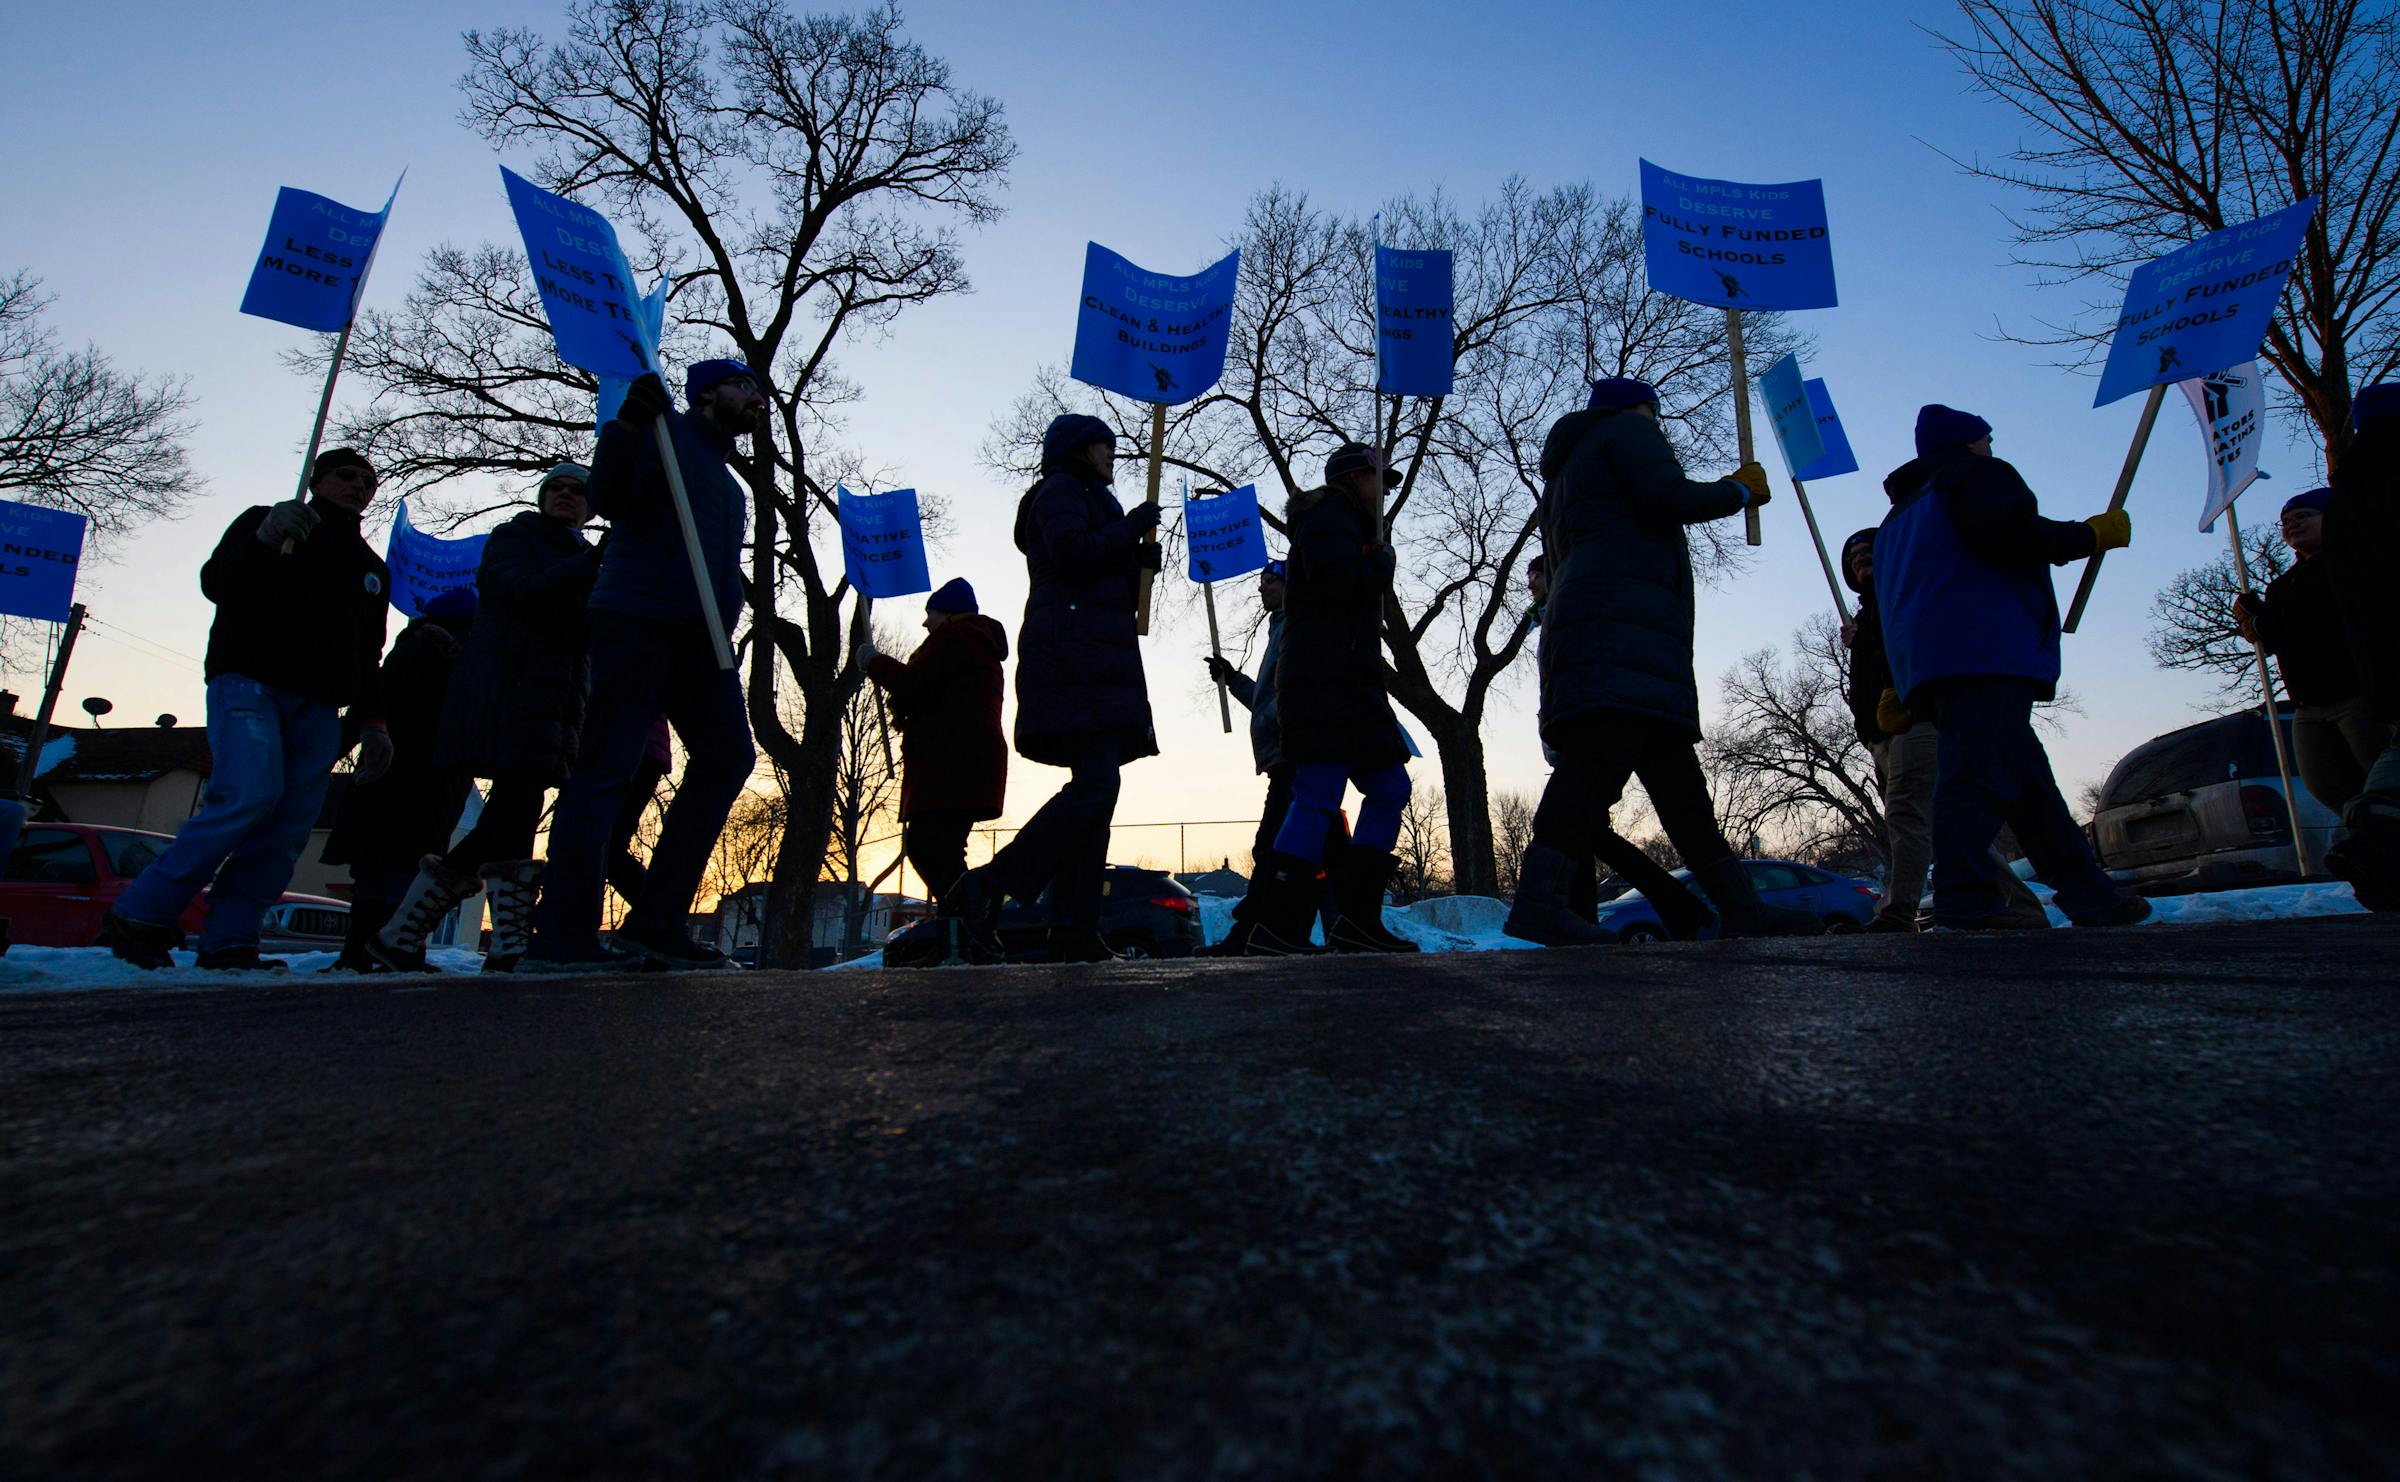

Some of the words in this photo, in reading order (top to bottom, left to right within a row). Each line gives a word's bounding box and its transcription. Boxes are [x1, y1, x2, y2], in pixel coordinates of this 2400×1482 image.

[1662, 175, 1690, 192] ALL
[1695, 183, 1743, 199] MPLS
[1749, 190, 1790, 201] KIDS
[311, 202, 351, 224] ALL
[532, 193, 565, 219] ALL
[1679, 196, 1774, 220] DESERVE
[1644, 204, 1711, 237] FULLY
[1721, 225, 1826, 241] FUNDED
[283, 235, 354, 269] LESS
[555, 226, 616, 261] DESE
[1677, 240, 1785, 265] SCHOOLS
[2152, 260, 2176, 276] ALL
[2183, 234, 2231, 262] MPLS
[2238, 219, 2282, 241] KIDS
[263, 256, 340, 288] MORE
[540, 248, 597, 286] LESS
[1390, 256, 1424, 269] KIDS
[2158, 248, 2256, 293] DESERVE
[1113, 261, 1138, 282] ALL
[1143, 276, 1190, 293] MPLS
[538, 275, 600, 315] MORE
[1124, 285, 1209, 312] DESERVE
[2118, 296, 2177, 331] FULLY
[2183, 260, 2291, 304] FUNDED
[1084, 295, 1141, 330] CLEAN
[1147, 318, 1160, 333] &
[2136, 303, 2240, 347] SCHOOLS
[1117, 328, 1208, 354] BUILDINGS
[2213, 408, 2255, 441] ATORS
[2217, 447, 2241, 467] VES
[865, 498, 895, 509] KIDS
[1214, 495, 1238, 508] KIDS
[9, 507, 53, 523] KIDS
[1190, 518, 1250, 539] ORATIVE
[4, 543, 77, 565] NDED
[1191, 536, 1245, 553] CTICES
